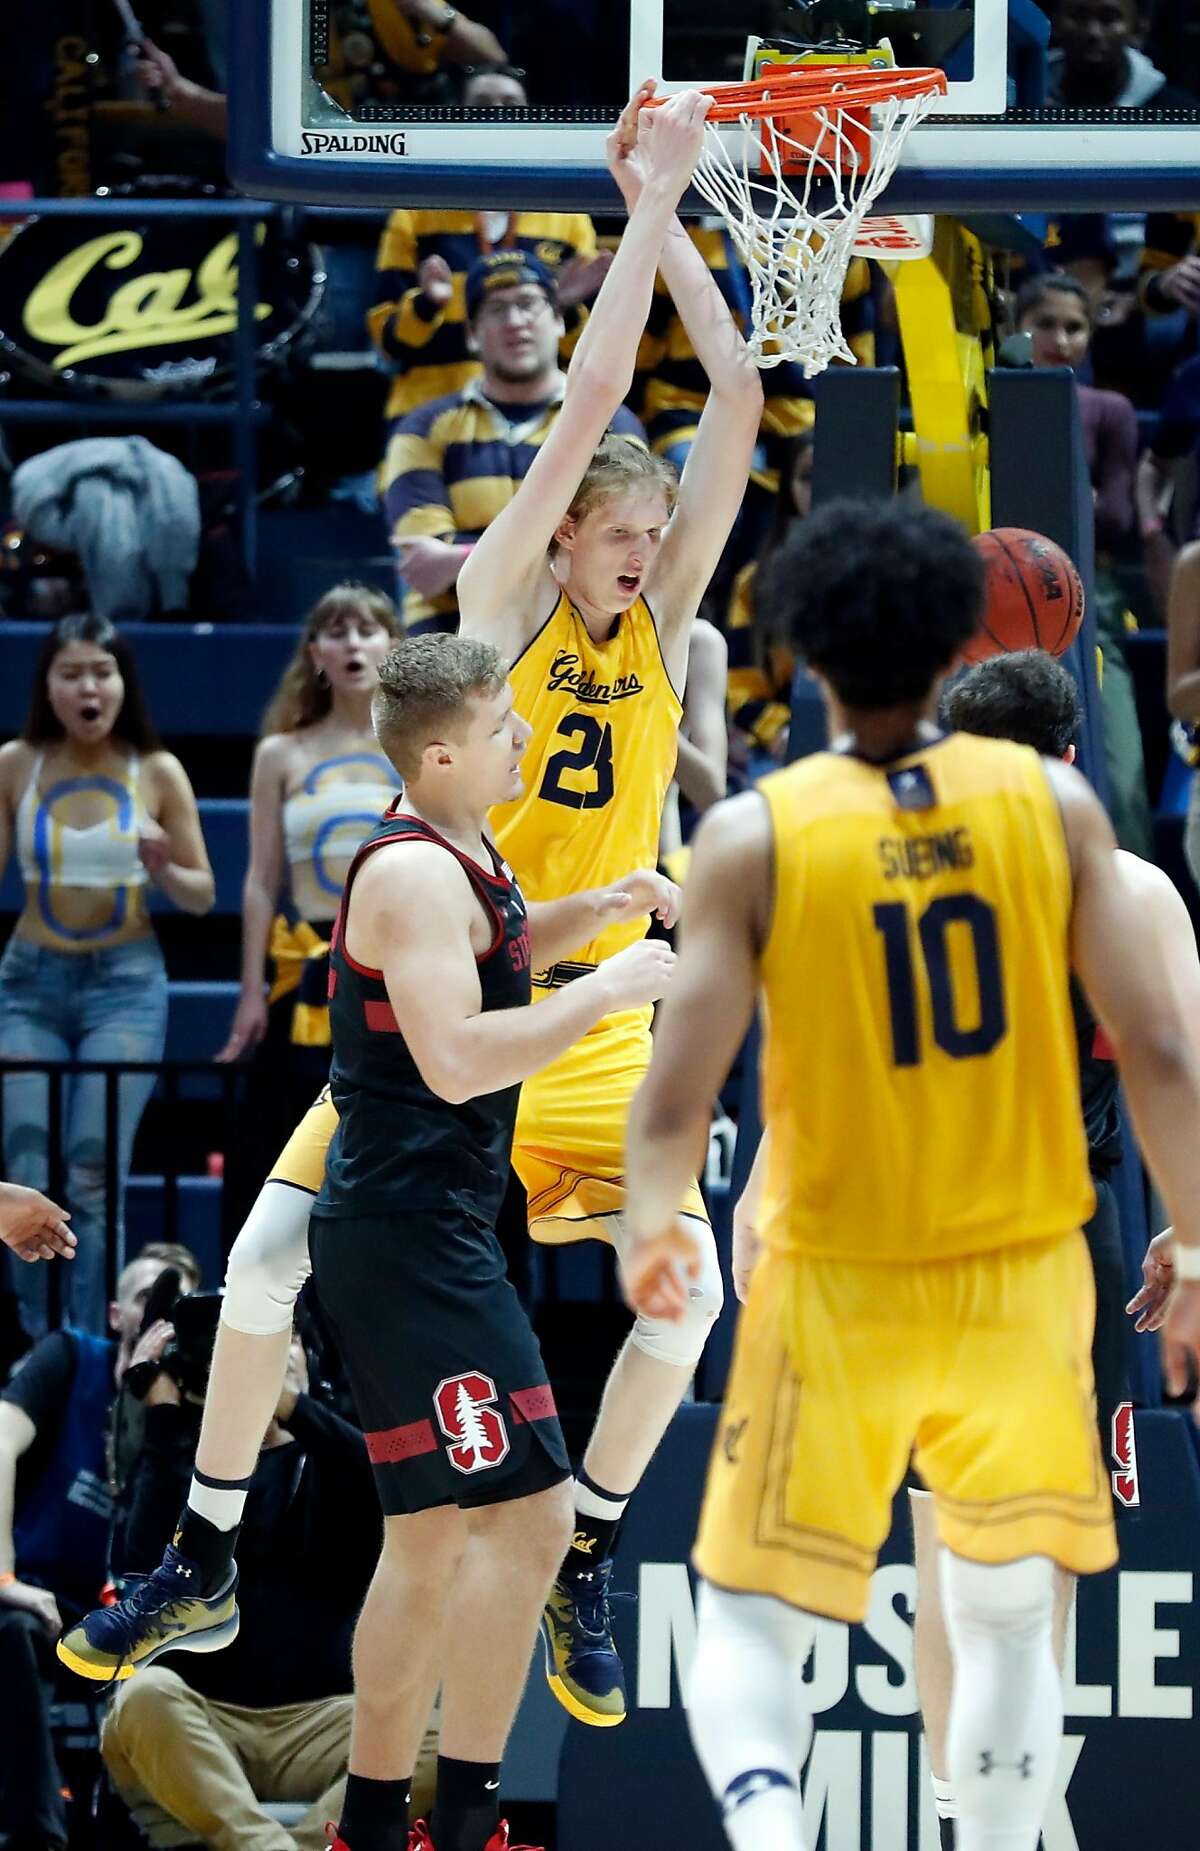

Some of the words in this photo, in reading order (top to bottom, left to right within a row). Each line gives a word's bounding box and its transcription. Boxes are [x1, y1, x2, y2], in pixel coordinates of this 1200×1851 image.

[301, 132, 406, 156] SPALDING
[22, 224, 273, 370] Cal
[873, 892, 1007, 1067] 10
[569, 1531, 598, 1555] Cal
[637, 1562, 1194, 1718] MSLE
